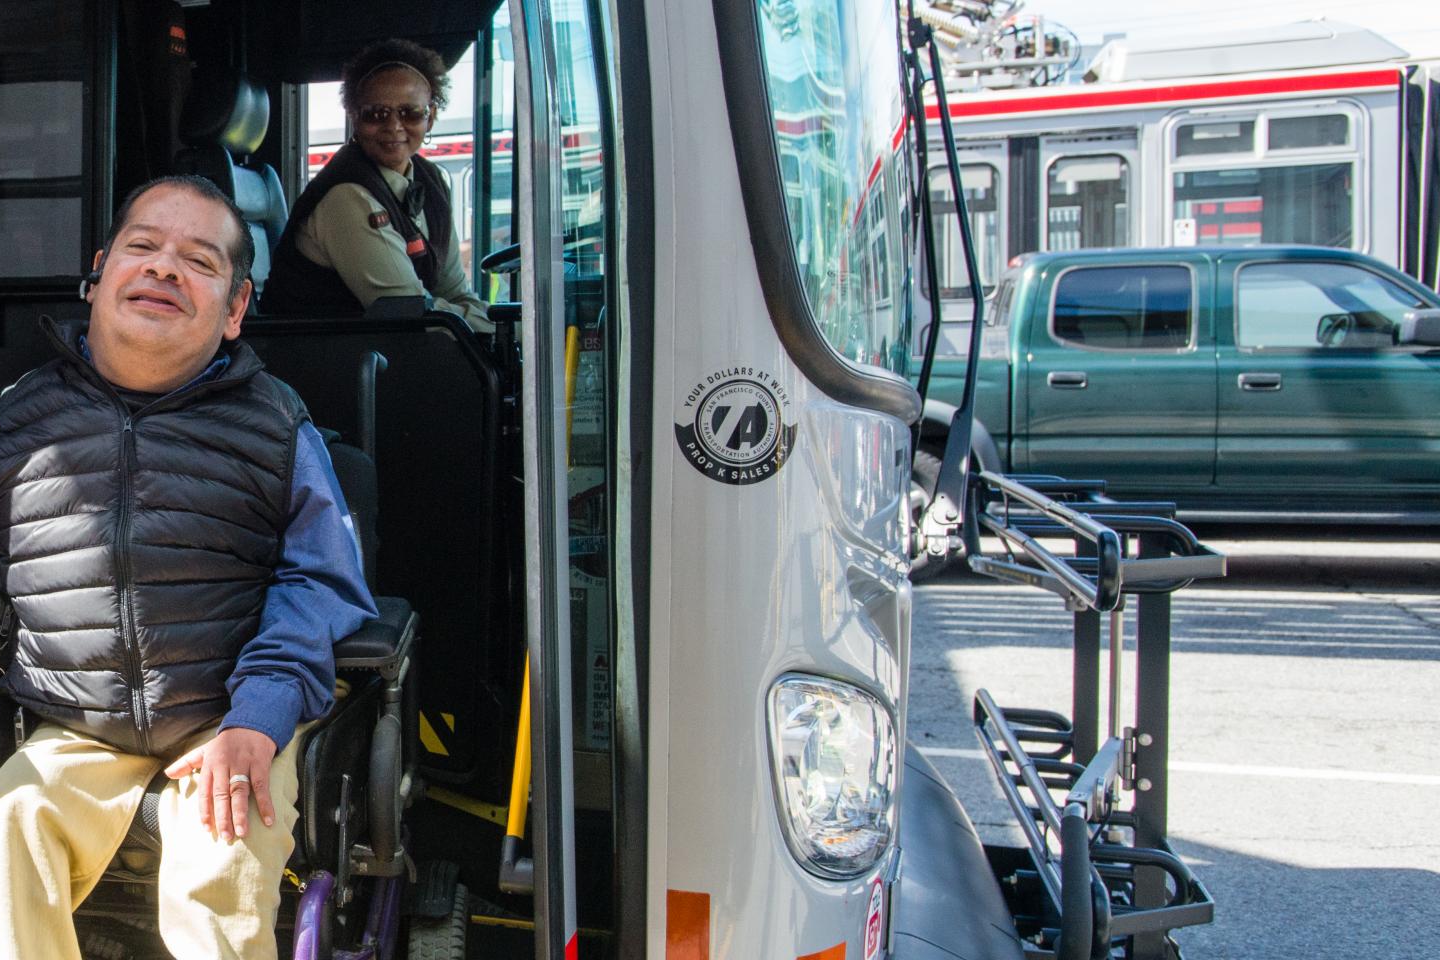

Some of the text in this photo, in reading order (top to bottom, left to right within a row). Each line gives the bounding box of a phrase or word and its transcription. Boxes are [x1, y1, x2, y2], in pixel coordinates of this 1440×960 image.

[684, 366, 791, 408] YOUR DOLLARS AT WORK
[706, 387, 773, 413] SAN FRANCISCO COUNTY
[704, 421, 775, 458] TRANSPORTATION AUTHORITY
[686, 442, 788, 480] PROP K SALES TAX
